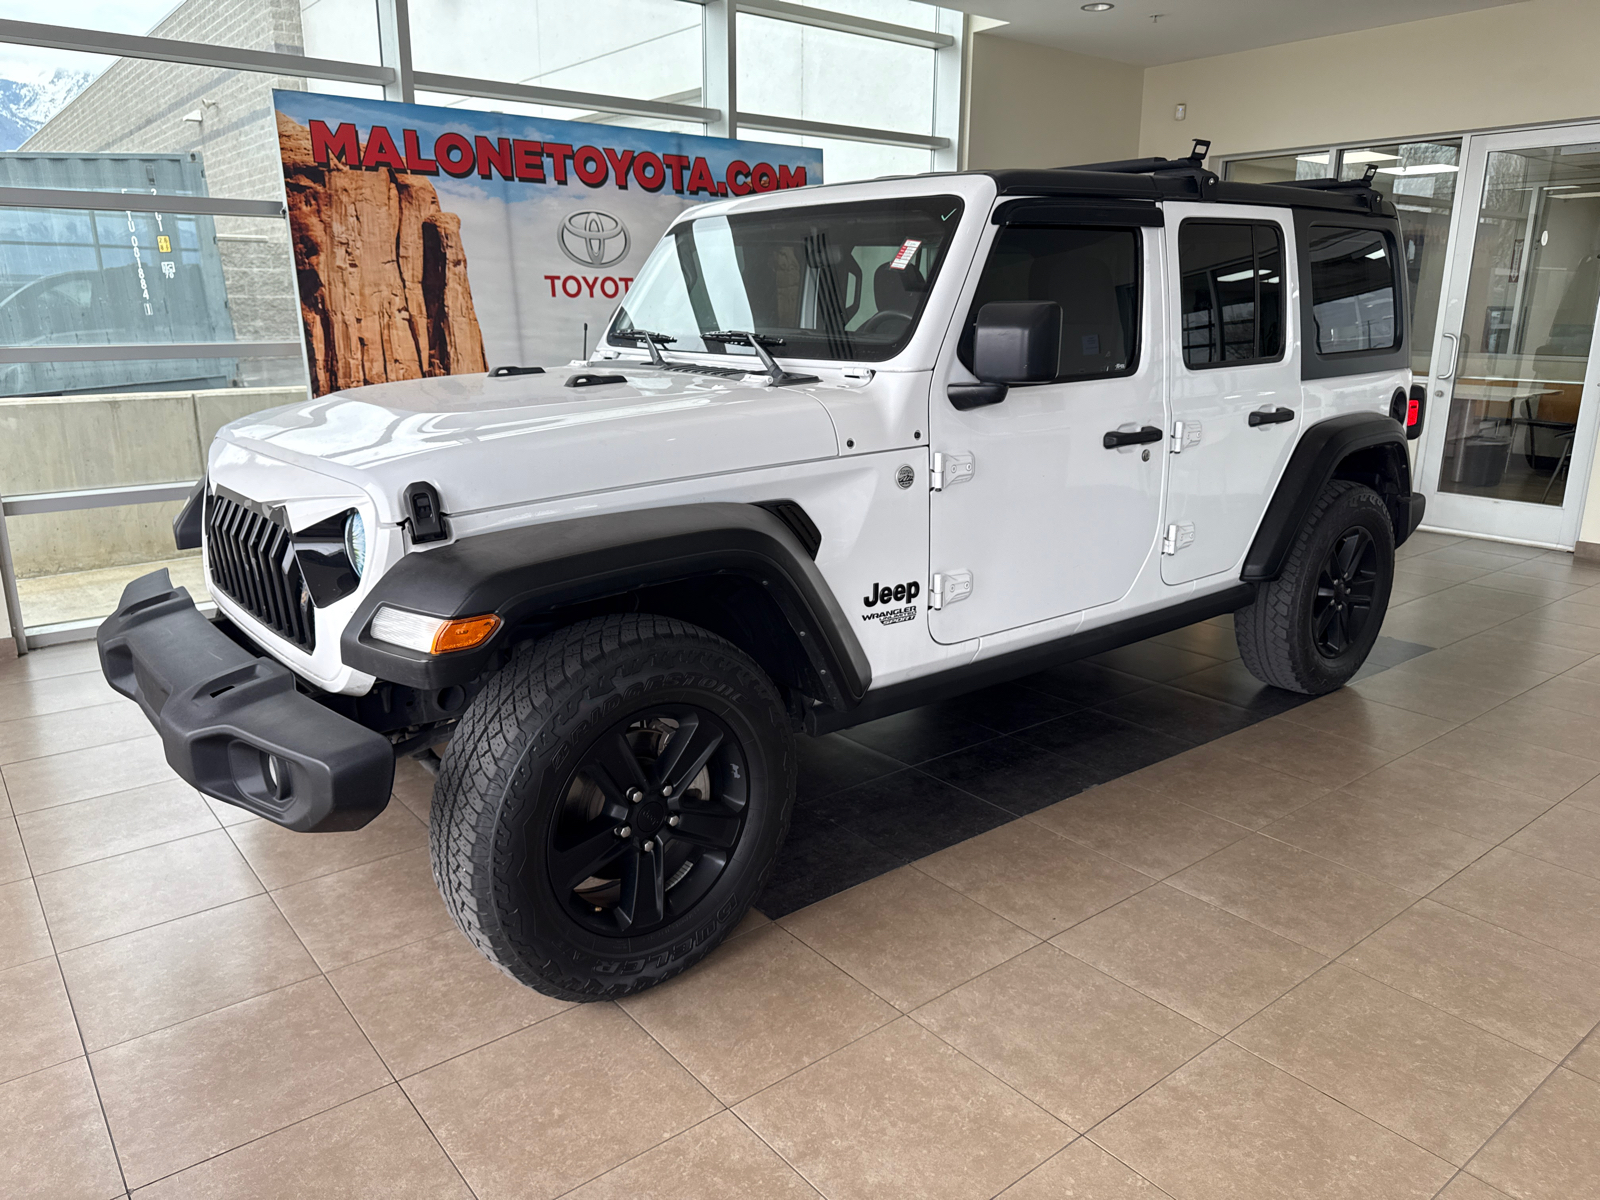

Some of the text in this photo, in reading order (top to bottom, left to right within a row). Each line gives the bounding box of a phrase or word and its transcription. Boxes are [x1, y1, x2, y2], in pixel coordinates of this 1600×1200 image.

[308, 118, 808, 198] MALONETOYOTA.COM
[543, 274, 635, 299] TOYOT
[863, 580, 920, 608] Jeep
[861, 605, 917, 621] WRANGLER
[551, 671, 748, 773] BRIDGESTONE
